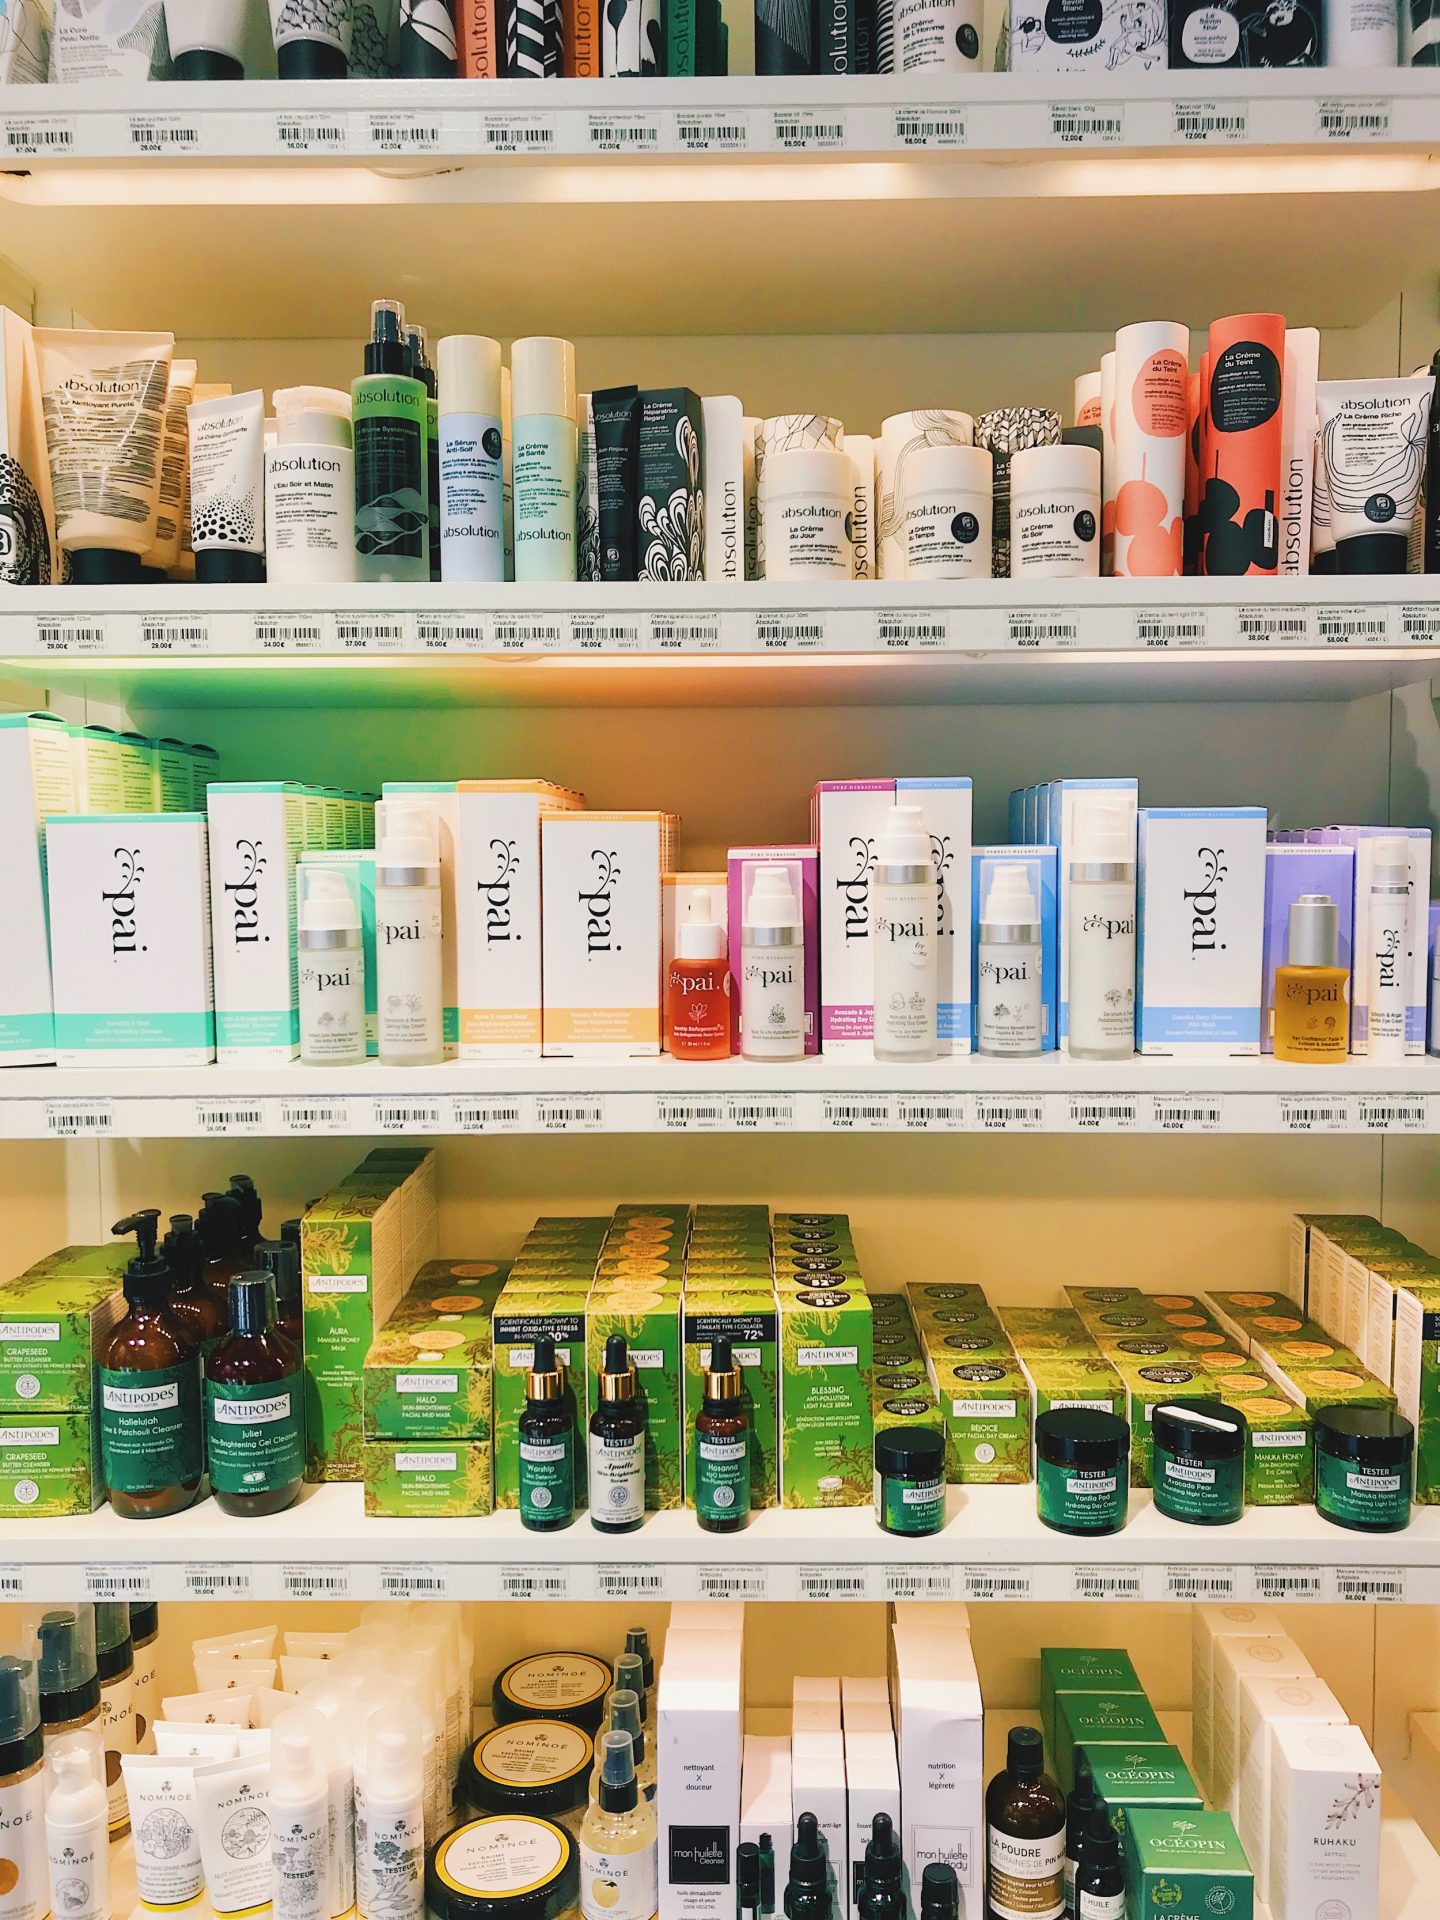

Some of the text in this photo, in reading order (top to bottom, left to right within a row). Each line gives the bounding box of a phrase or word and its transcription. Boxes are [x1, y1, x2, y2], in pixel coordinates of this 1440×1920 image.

[1236, 351, 1261, 359] Crème
[1162, 359, 1182, 367] Crème
[1237, 358, 1253, 366] Teint
[1340, 396, 1411, 410] absolution
[446, 446, 474, 454] Anti-Soif
[269, 455, 341, 474] absolution
[289, 481, 334, 490] Soir Matin
[782, 504, 842, 519] absolution
[914, 524, 935, 533] Crème
[1030, 523, 1054, 531] Crème
[444, 526, 500, 539] absolution
[516, 528, 572, 542] absolution
[914, 532, 935, 540] Temps
[1030, 530, 1044, 538] Soir
[386, 920, 421, 944] pai
[890, 917, 926, 940] pai
[762, 966, 792, 988] pai
[996, 962, 1027, 984] pai
[317, 968, 351, 991] pai
[1306, 984, 1338, 1004] pai
[744, 1330, 764, 1340] 72%
[7, 1348, 48, 1356] GRAPESEED
[812, 1386, 844, 1394] BLESSING
[416, 1396, 436, 1404] HALO
[118, 1417, 158, 1426] Hallelujah
[120, 1422, 183, 1436] Patchouli Cleanser
[971, 1424, 998, 1432] REJOICE
[242, 1430, 262, 1439] Juliet
[272, 1431, 298, 1443] Cleanser
[605, 1438, 634, 1446] TESTER
[711, 1436, 736, 1444] TESTER
[1176, 1456, 1202, 1467] TESTER
[528, 1464, 554, 1474] Worship
[1362, 1467, 1390, 1476] TESTER
[416, 1474, 436, 1482] HALO
[1080, 1470, 1106, 1478] TESTER
[918, 1479, 938, 1488] TESTER
[1168, 1478, 1195, 1489] Avocado
[1075, 1494, 1110, 1502] Vanilla Pod
[684, 1764, 714, 1772] nettoyant
[1106, 1770, 1176, 1780] OCÉOPIN
[1150, 1838, 1225, 1849] OCÉOPIN
[1314, 1837, 1356, 1846] RUHAKU
[674, 1842, 722, 1864] mon huilette
[1002, 1842, 1041, 1858] POUDRE
[917, 1852, 936, 1860] mon
[1045, 1856, 1057, 1866] PIN
[384, 1862, 416, 1874] TESTEUR
[284, 1870, 315, 1880] TESTEUR
